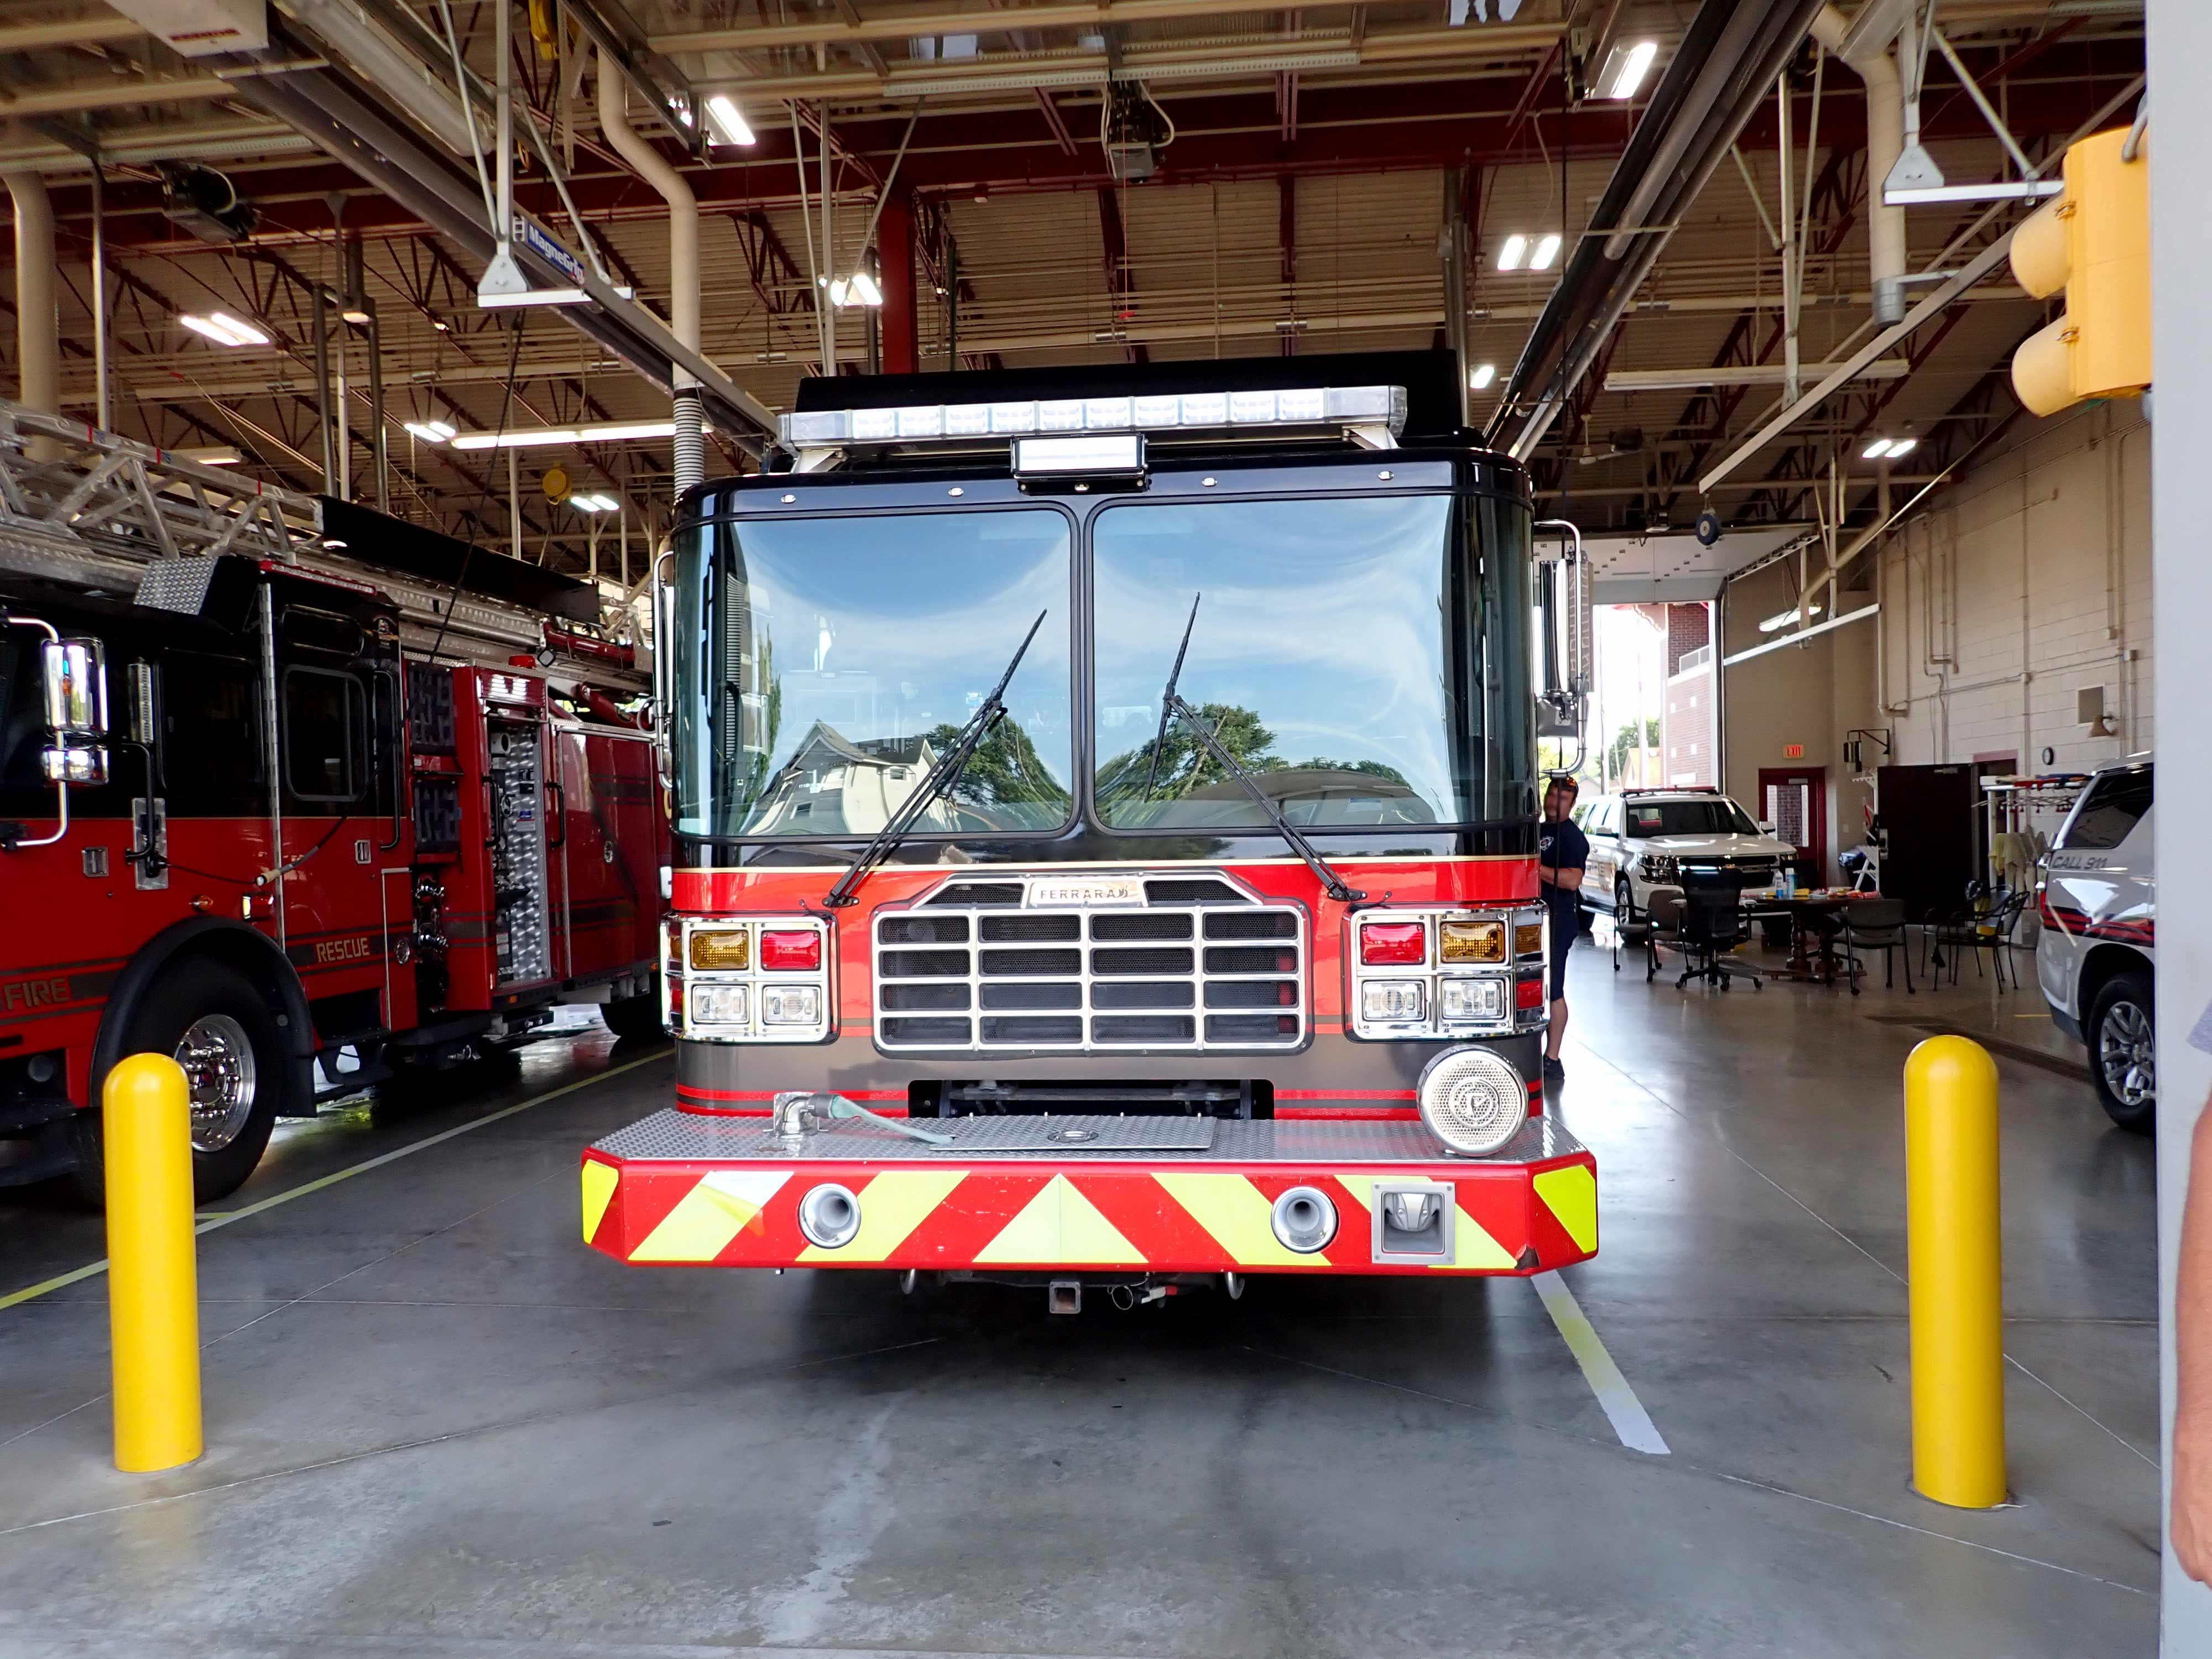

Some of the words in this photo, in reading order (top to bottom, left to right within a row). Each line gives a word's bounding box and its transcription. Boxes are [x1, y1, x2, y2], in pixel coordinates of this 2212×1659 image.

[2052, 855, 2081, 869] CALL
[2084, 857, 2107, 870] 911
[1040, 889, 1115, 899] FERRARA
[316, 937, 370, 963] RESCUE
[3, 977, 70, 1010] FIRE
